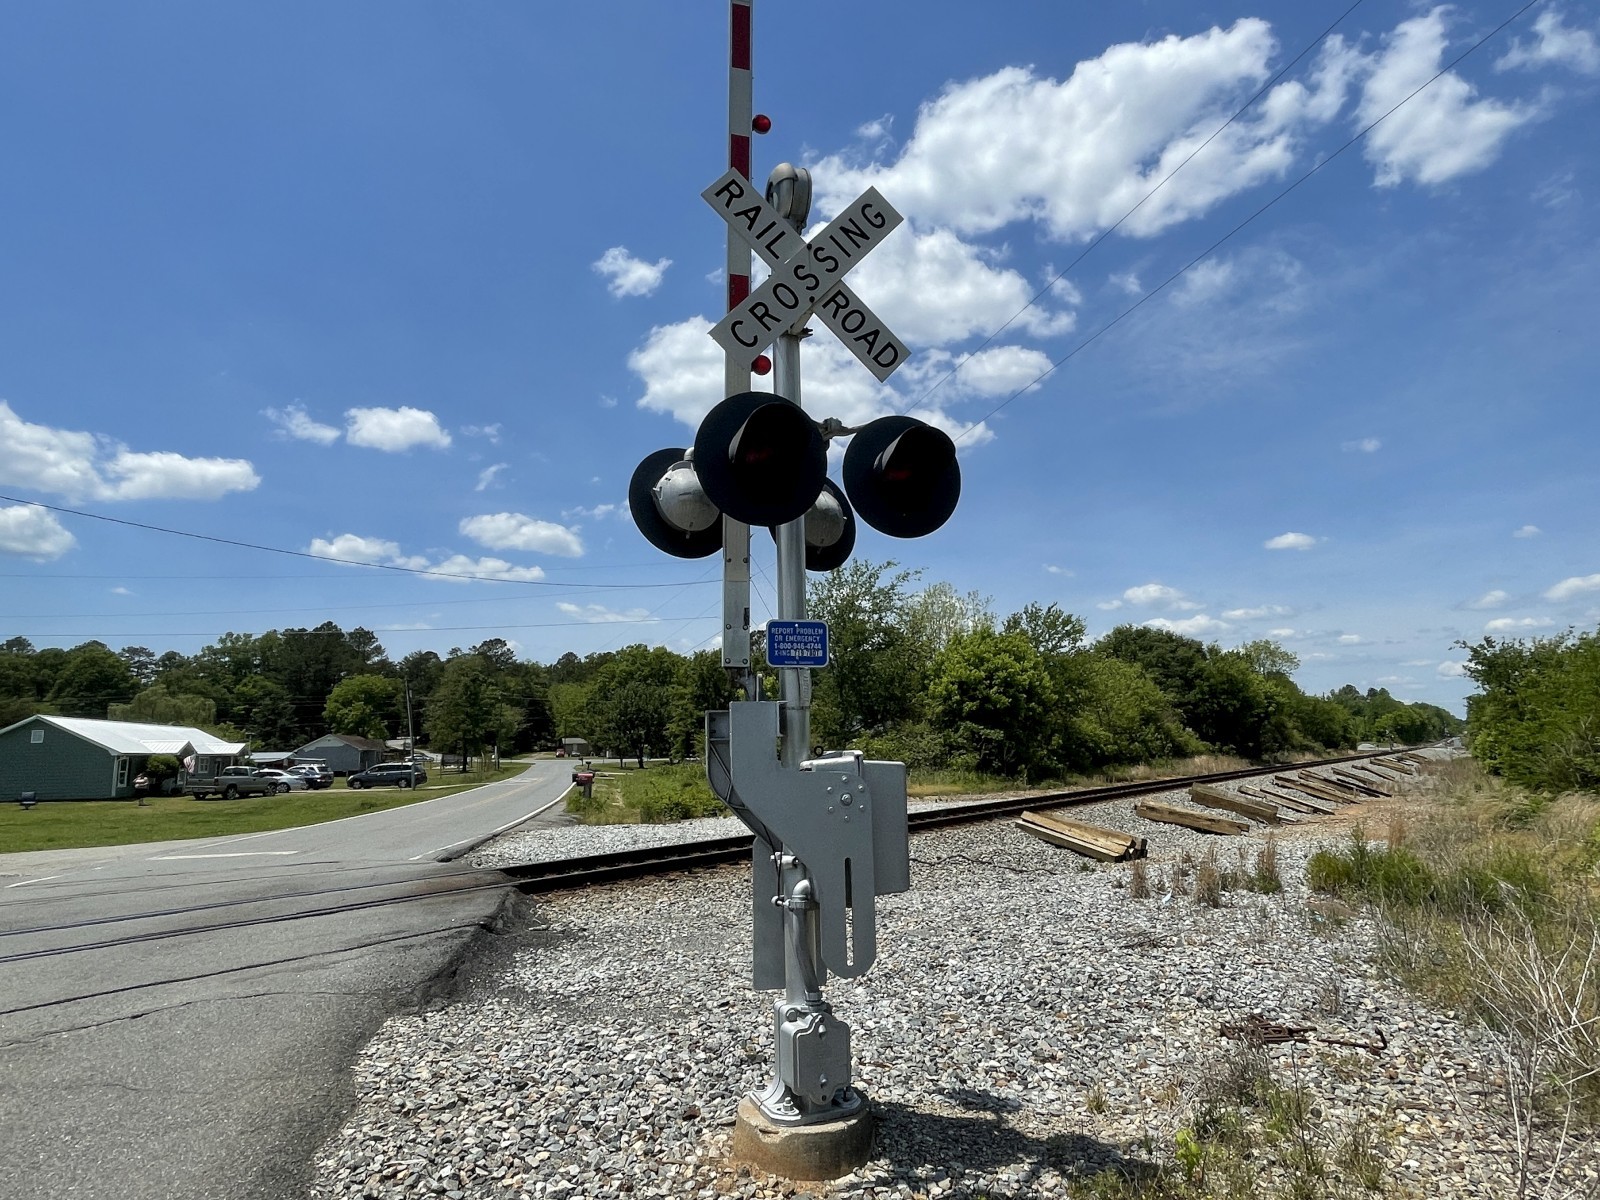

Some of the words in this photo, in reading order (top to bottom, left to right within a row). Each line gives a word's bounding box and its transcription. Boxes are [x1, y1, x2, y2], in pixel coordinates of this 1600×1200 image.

[714, 178, 787, 260] RAIL
[821, 289, 899, 368] ROAD
[730, 203, 886, 348] CROSSING
